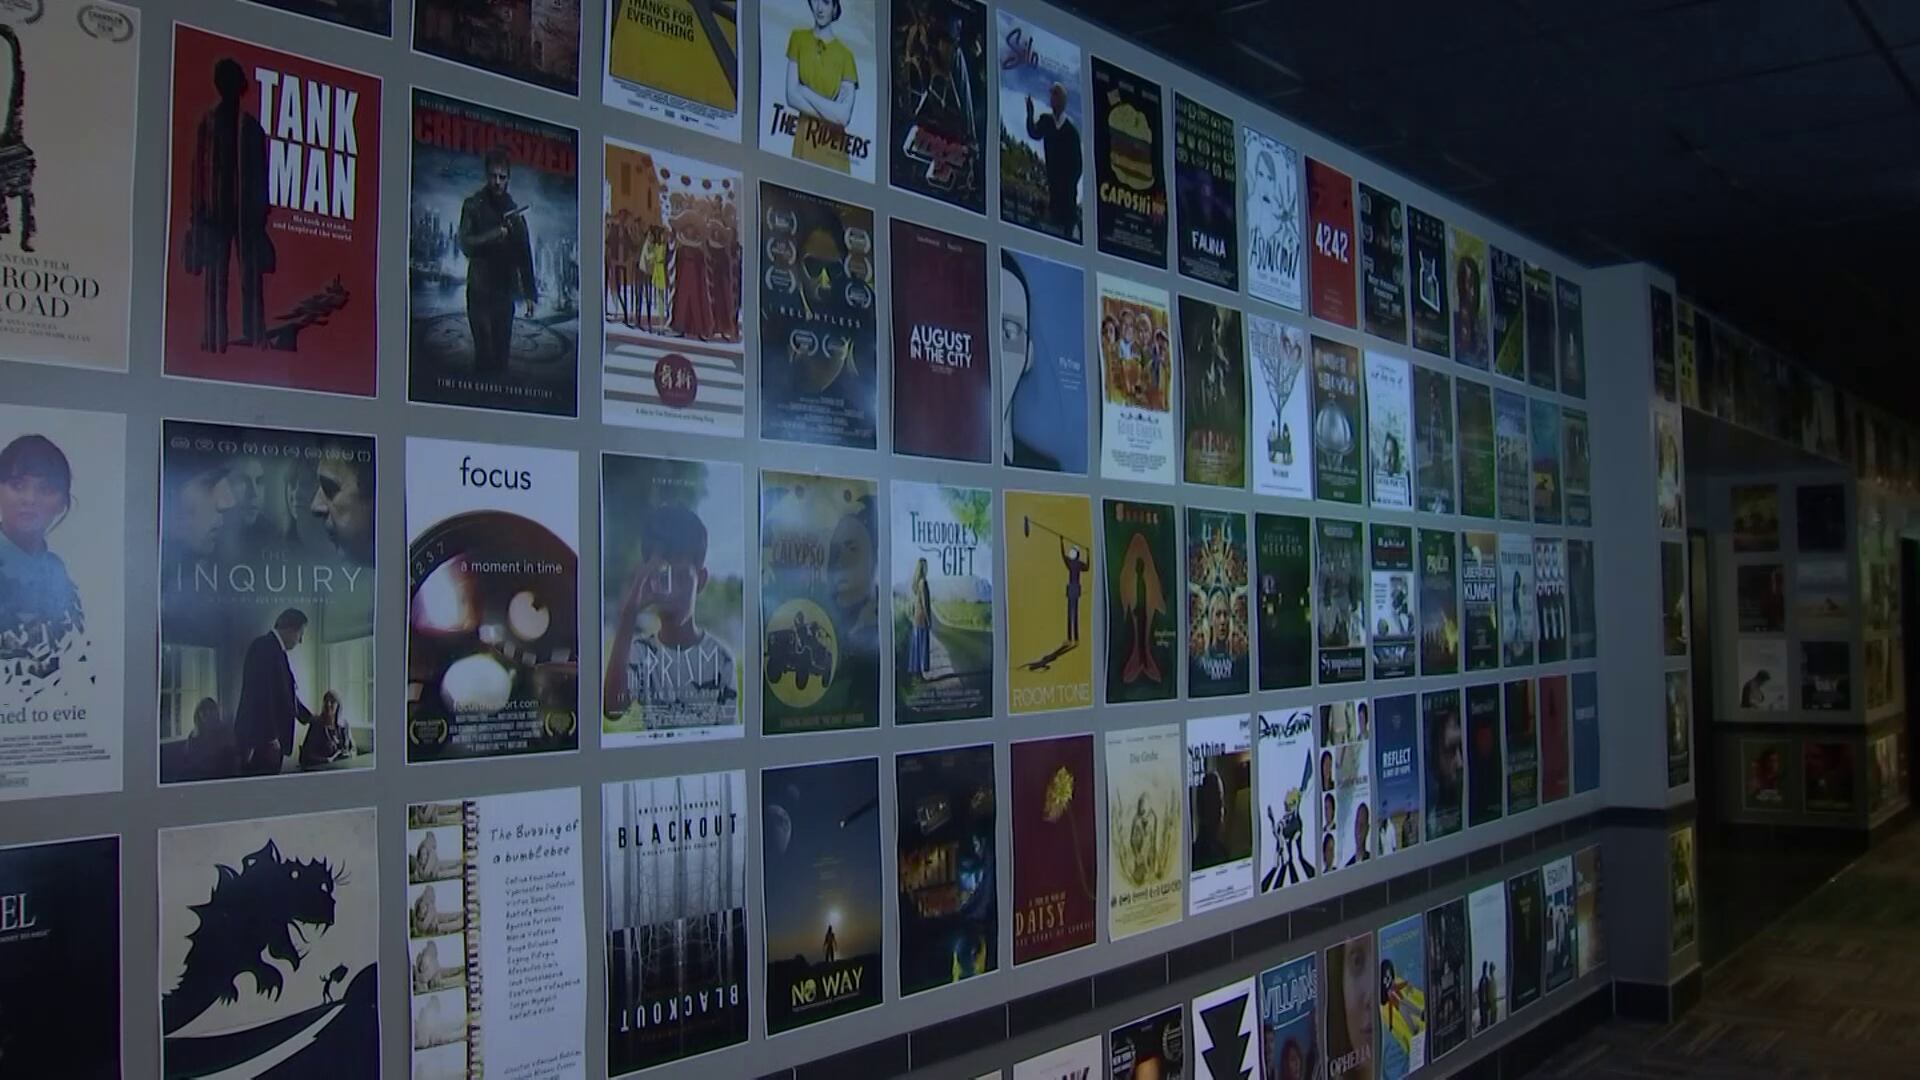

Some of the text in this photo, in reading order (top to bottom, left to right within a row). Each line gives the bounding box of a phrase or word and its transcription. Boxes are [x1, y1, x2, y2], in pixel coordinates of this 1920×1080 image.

[627, 7, 695, 43] EVERYTHING
[672, 10, 693, 28] FOR
[255, 67, 359, 154] TANK
[268, 138, 357, 221] MAN
[1315, 221, 1349, 264] 4242
[0, 291, 70, 318] OAD
[910, 341, 973, 369] IN THE CITY
[911, 324, 972, 353] AUGUST
[460, 455, 532, 490] focus
[910, 511, 979, 547] THEODORE'S
[460, 559, 564, 575] a moment in time
[942, 545, 977, 577] GIFT
[177, 563, 363, 593] INQUIRY
[32, 708, 48, 722] to
[53, 704, 87, 722] evie
[490, 829, 513, 842] The
[565, 818, 580, 833] of
[618, 812, 737, 848] BLACKOUT
[505, 844, 571, 864] bumblebee
[1015, 900, 1066, 937] DAISY
[791, 965, 865, 1007] NO WAY
[619, 982, 739, 1033] BLACKOUT
